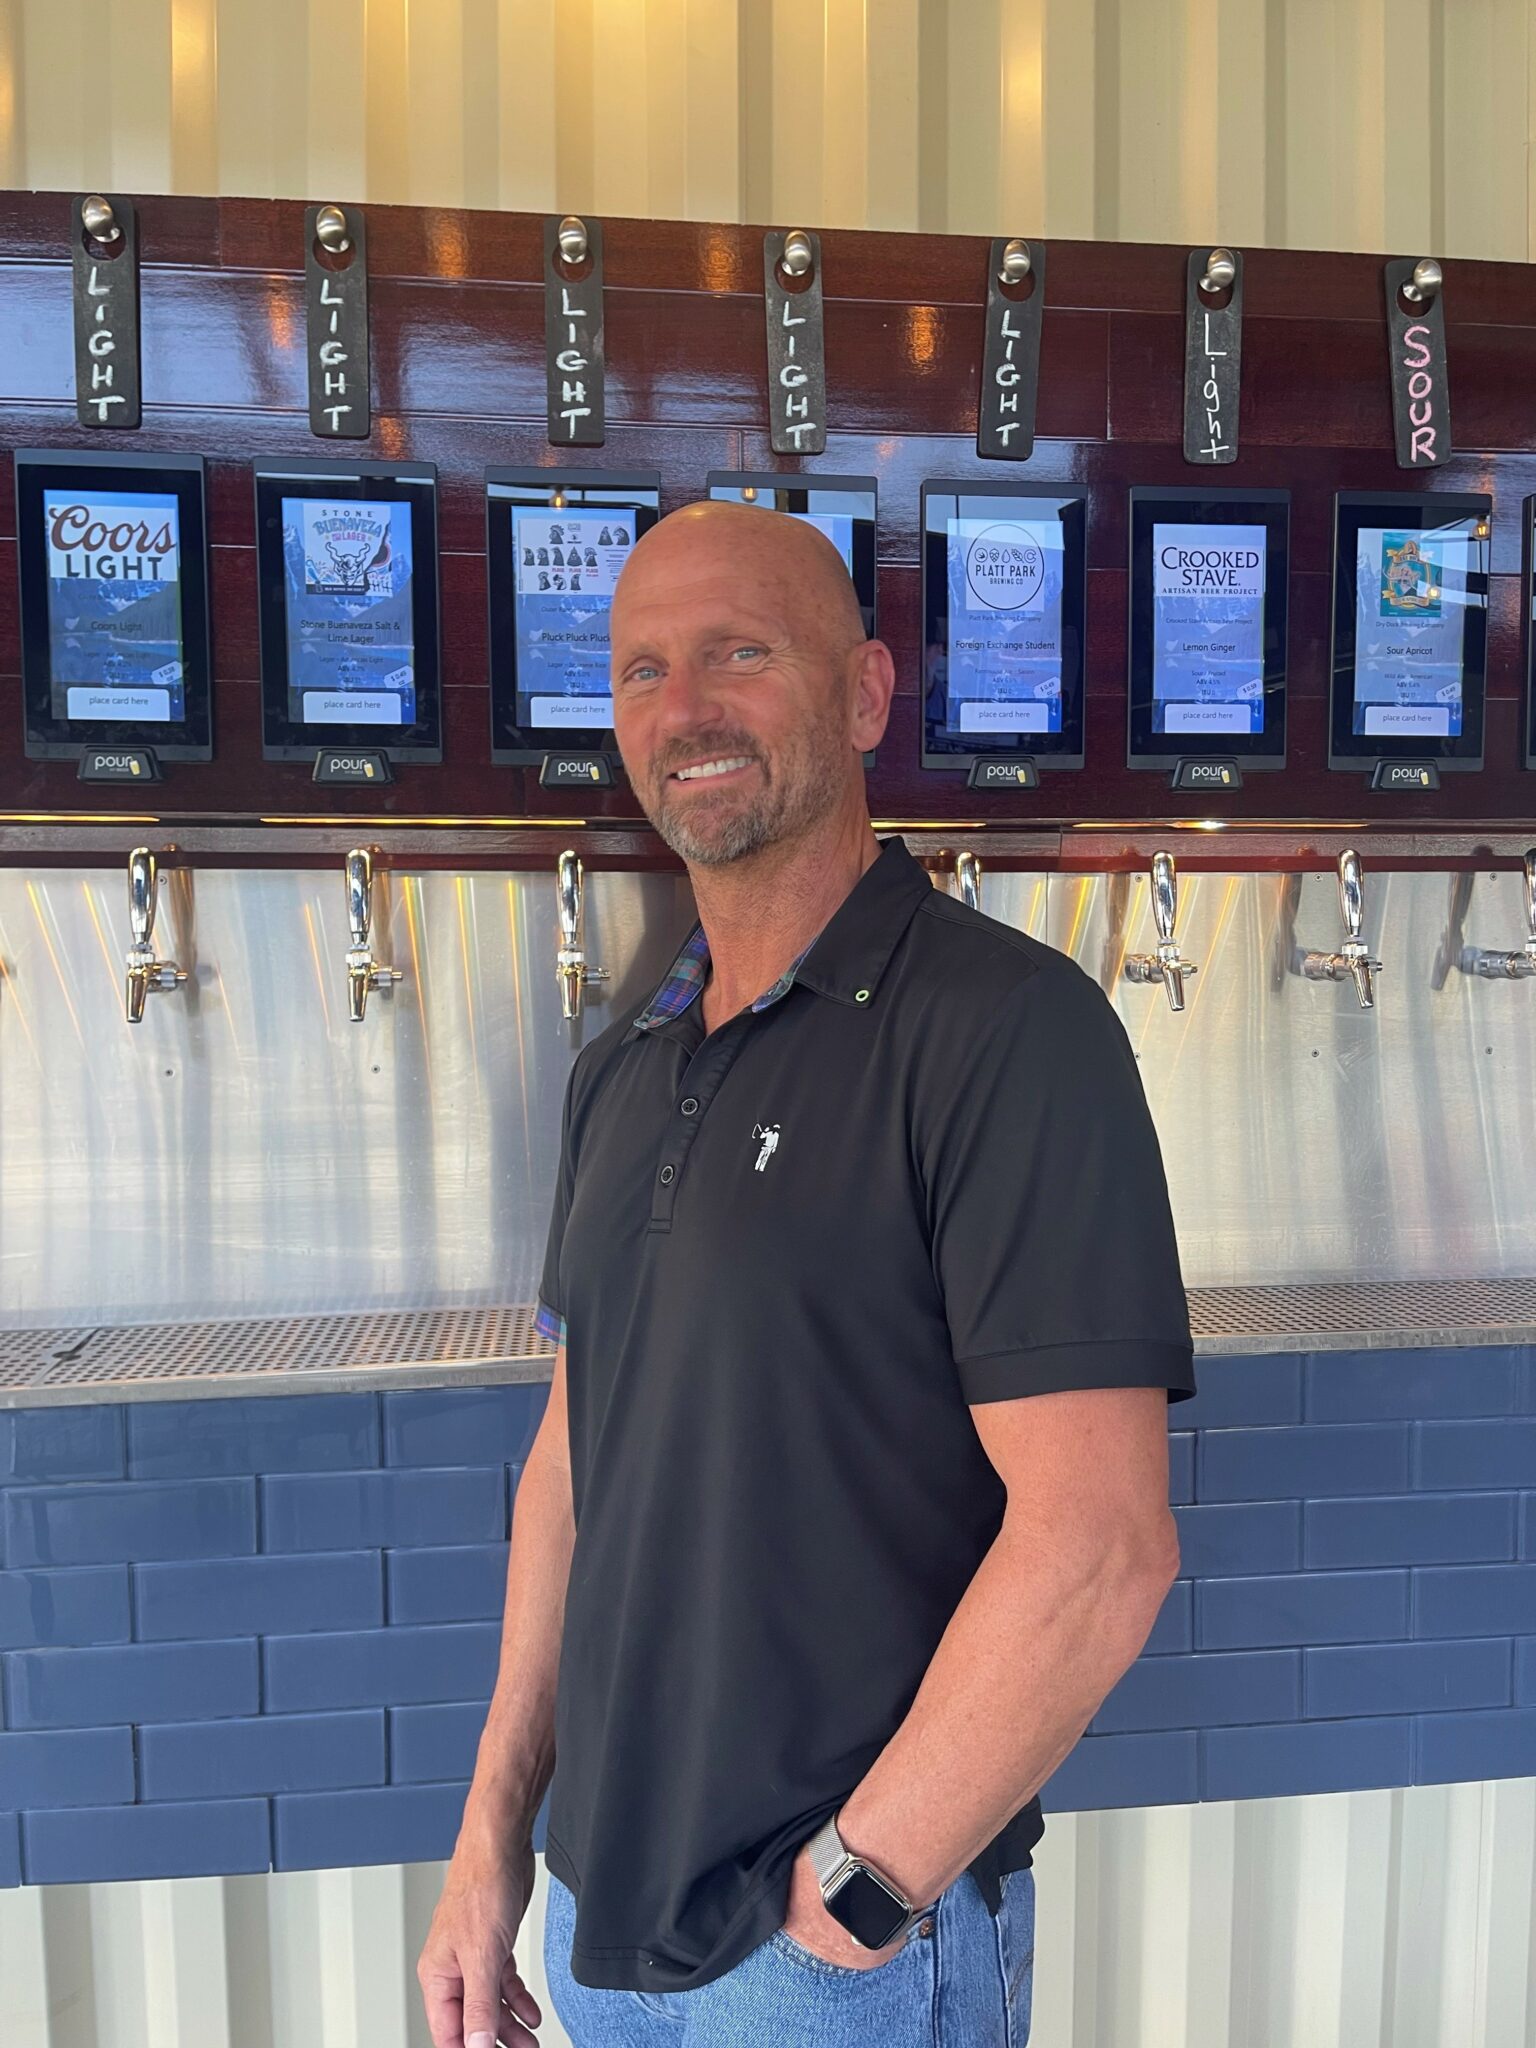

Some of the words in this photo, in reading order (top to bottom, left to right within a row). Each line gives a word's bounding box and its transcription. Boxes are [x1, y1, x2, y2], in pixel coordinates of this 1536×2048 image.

[88, 267, 124, 421] LIGHT
[320, 279, 352, 431] LIGHT
[555, 288, 591, 438] LIGHT
[779, 301, 816, 448] LIGHT
[994, 309, 1021, 448] LIGHT
[1200, 312, 1229, 460] Light
[1403, 326, 1436, 462] SOUR
[322, 509, 373, 518] STONE
[49, 505, 176, 554] Coors
[312, 517, 382, 538] BUENAVEZA
[1161, 546, 1259, 570] CROOKED
[66, 554, 162, 580] LIGHT
[976, 565, 1005, 577] PLATT
[1010, 565, 1036, 577] PARK
[91, 621, 117, 631] Coors
[300, 619, 326, 629] Stone
[328, 620, 373, 630] Buenaveza
[375, 621, 391, 630] Salt
[393, 621, 401, 630] &
[328, 633, 348, 643] Lime
[351, 634, 375, 645] Lager
[542, 632, 563, 642] Pluck
[566, 633, 588, 642] Pluck
[955, 640, 985, 651] Foreign
[987, 640, 1024, 651] Exchange
[1025, 641, 1056, 650] Student
[1182, 643, 1209, 652] Lemon
[1210, 643, 1236, 653] Ginger
[1386, 646, 1404, 655] Sour
[1405, 646, 1433, 656] Apricot
[89, 696, 110, 706] place
[112, 695, 129, 705] card
[131, 696, 149, 705] here
[323, 700, 344, 709] place
[345, 700, 363, 709] card
[364, 700, 382, 709] here
[550, 704, 570, 714] place
[571, 705, 588, 713] card
[589, 705, 606, 714] here
[978, 711, 998, 719] place
[998, 711, 1014, 719] card
[1182, 712, 1200, 720] place
[1382, 714, 1401, 722] place
[1417, 714, 1432, 722] here
[95, 756, 132, 770] pour
[330, 759, 367, 773] pour
[558, 762, 592, 776] pour
[987, 765, 1020, 780] pour
[1192, 766, 1224, 780] pour
[1391, 768, 1423, 781] pour
